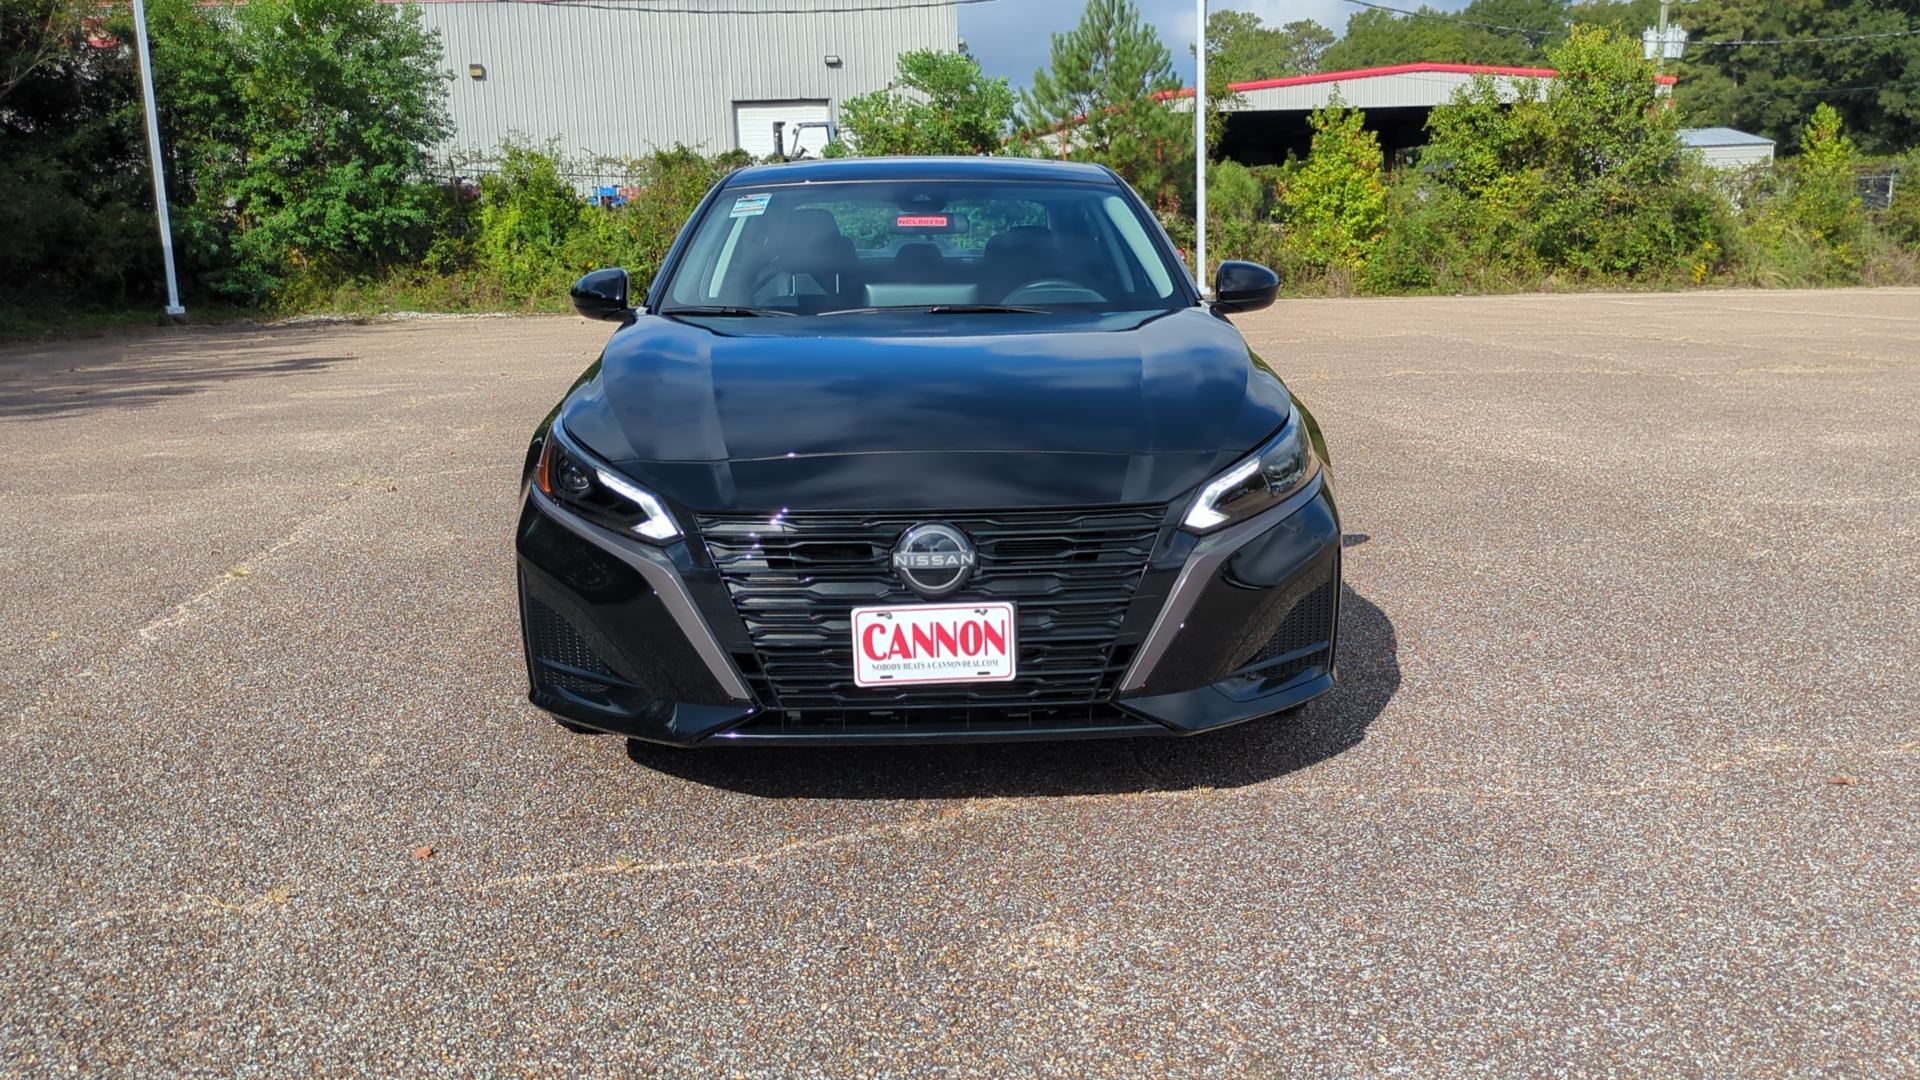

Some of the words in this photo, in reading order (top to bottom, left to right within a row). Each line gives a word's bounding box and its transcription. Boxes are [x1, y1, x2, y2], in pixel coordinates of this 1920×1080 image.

[895, 554, 973, 566] NISSAN
[862, 619, 1006, 661] CANNON
[871, 663, 901, 671] NOBODY
[903, 661, 926, 670] BEATS
[932, 661, 961, 669] CANNON
[962, 659, 999, 668] DEAL.COM
